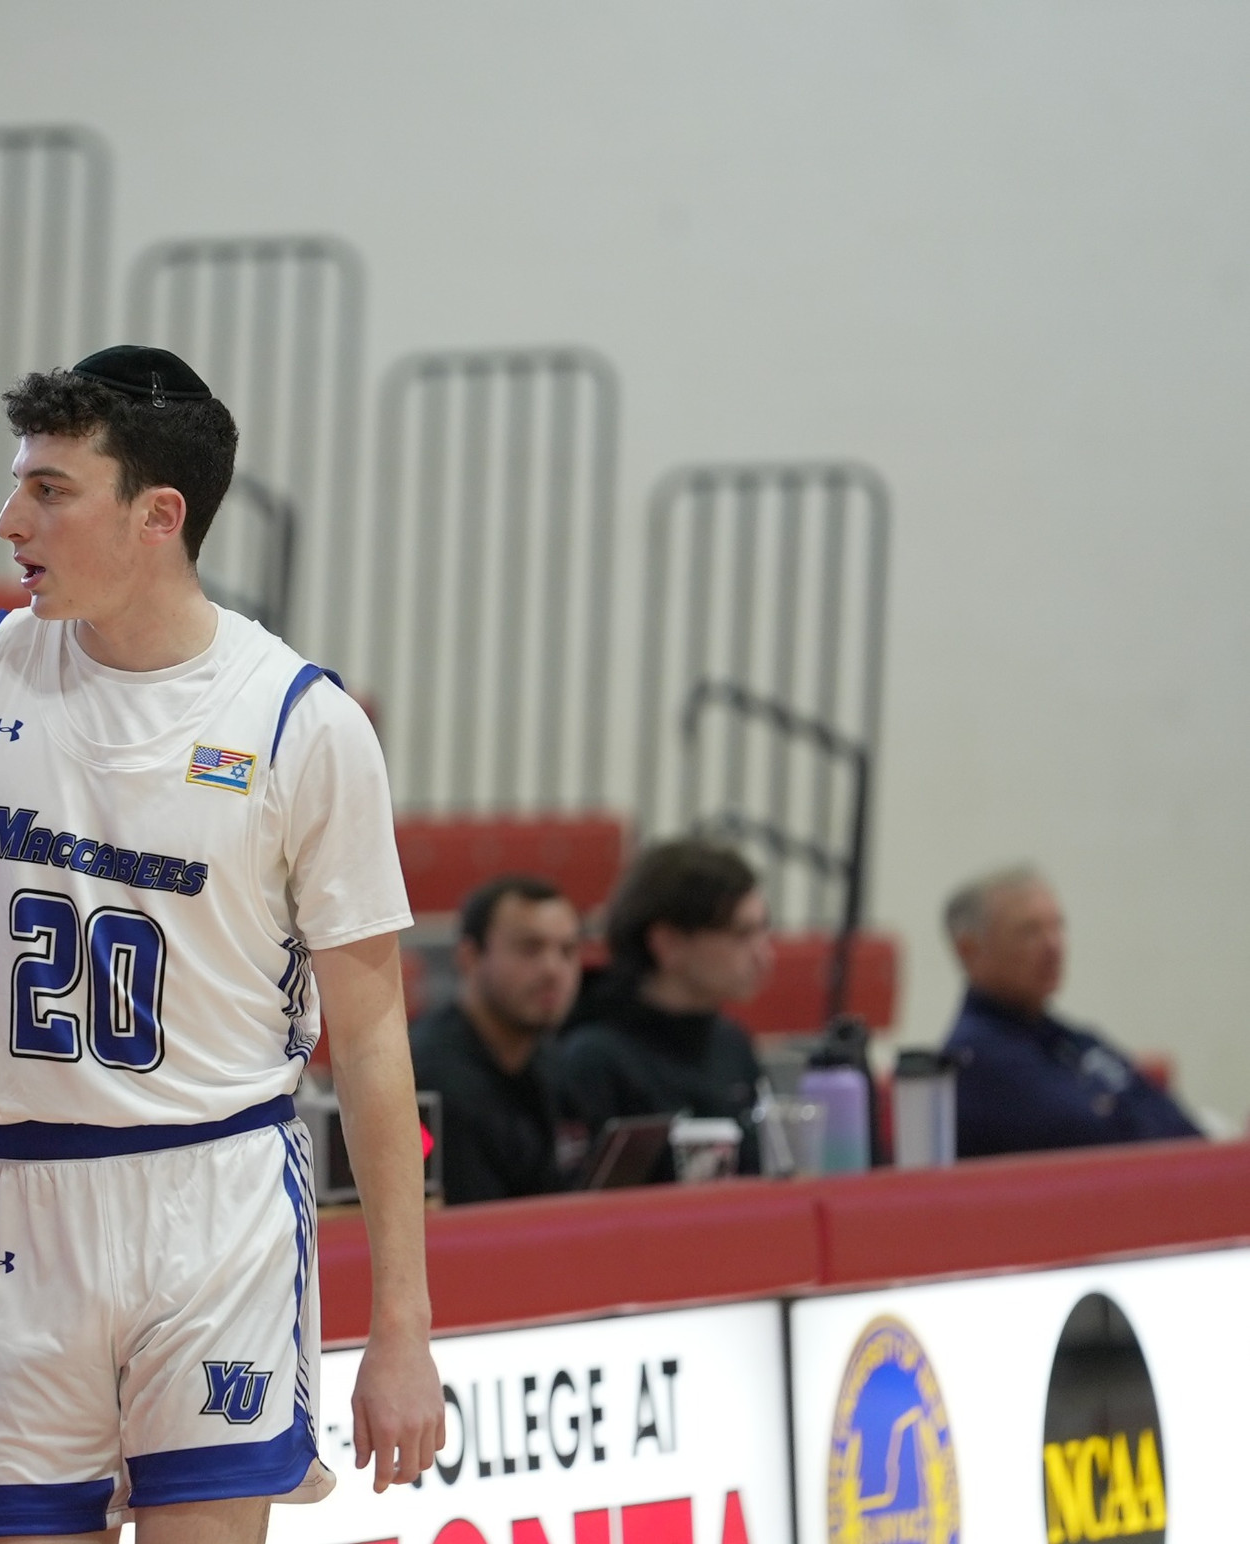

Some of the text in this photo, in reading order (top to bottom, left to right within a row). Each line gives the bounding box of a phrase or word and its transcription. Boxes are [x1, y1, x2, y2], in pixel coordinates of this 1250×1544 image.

[9, 888, 167, 1073] 20
[199, 1361, 273, 1425] YU
[411, 1359, 678, 1489] OLLEGE AT
[1044, 1428, 1166, 1544] NCAA
